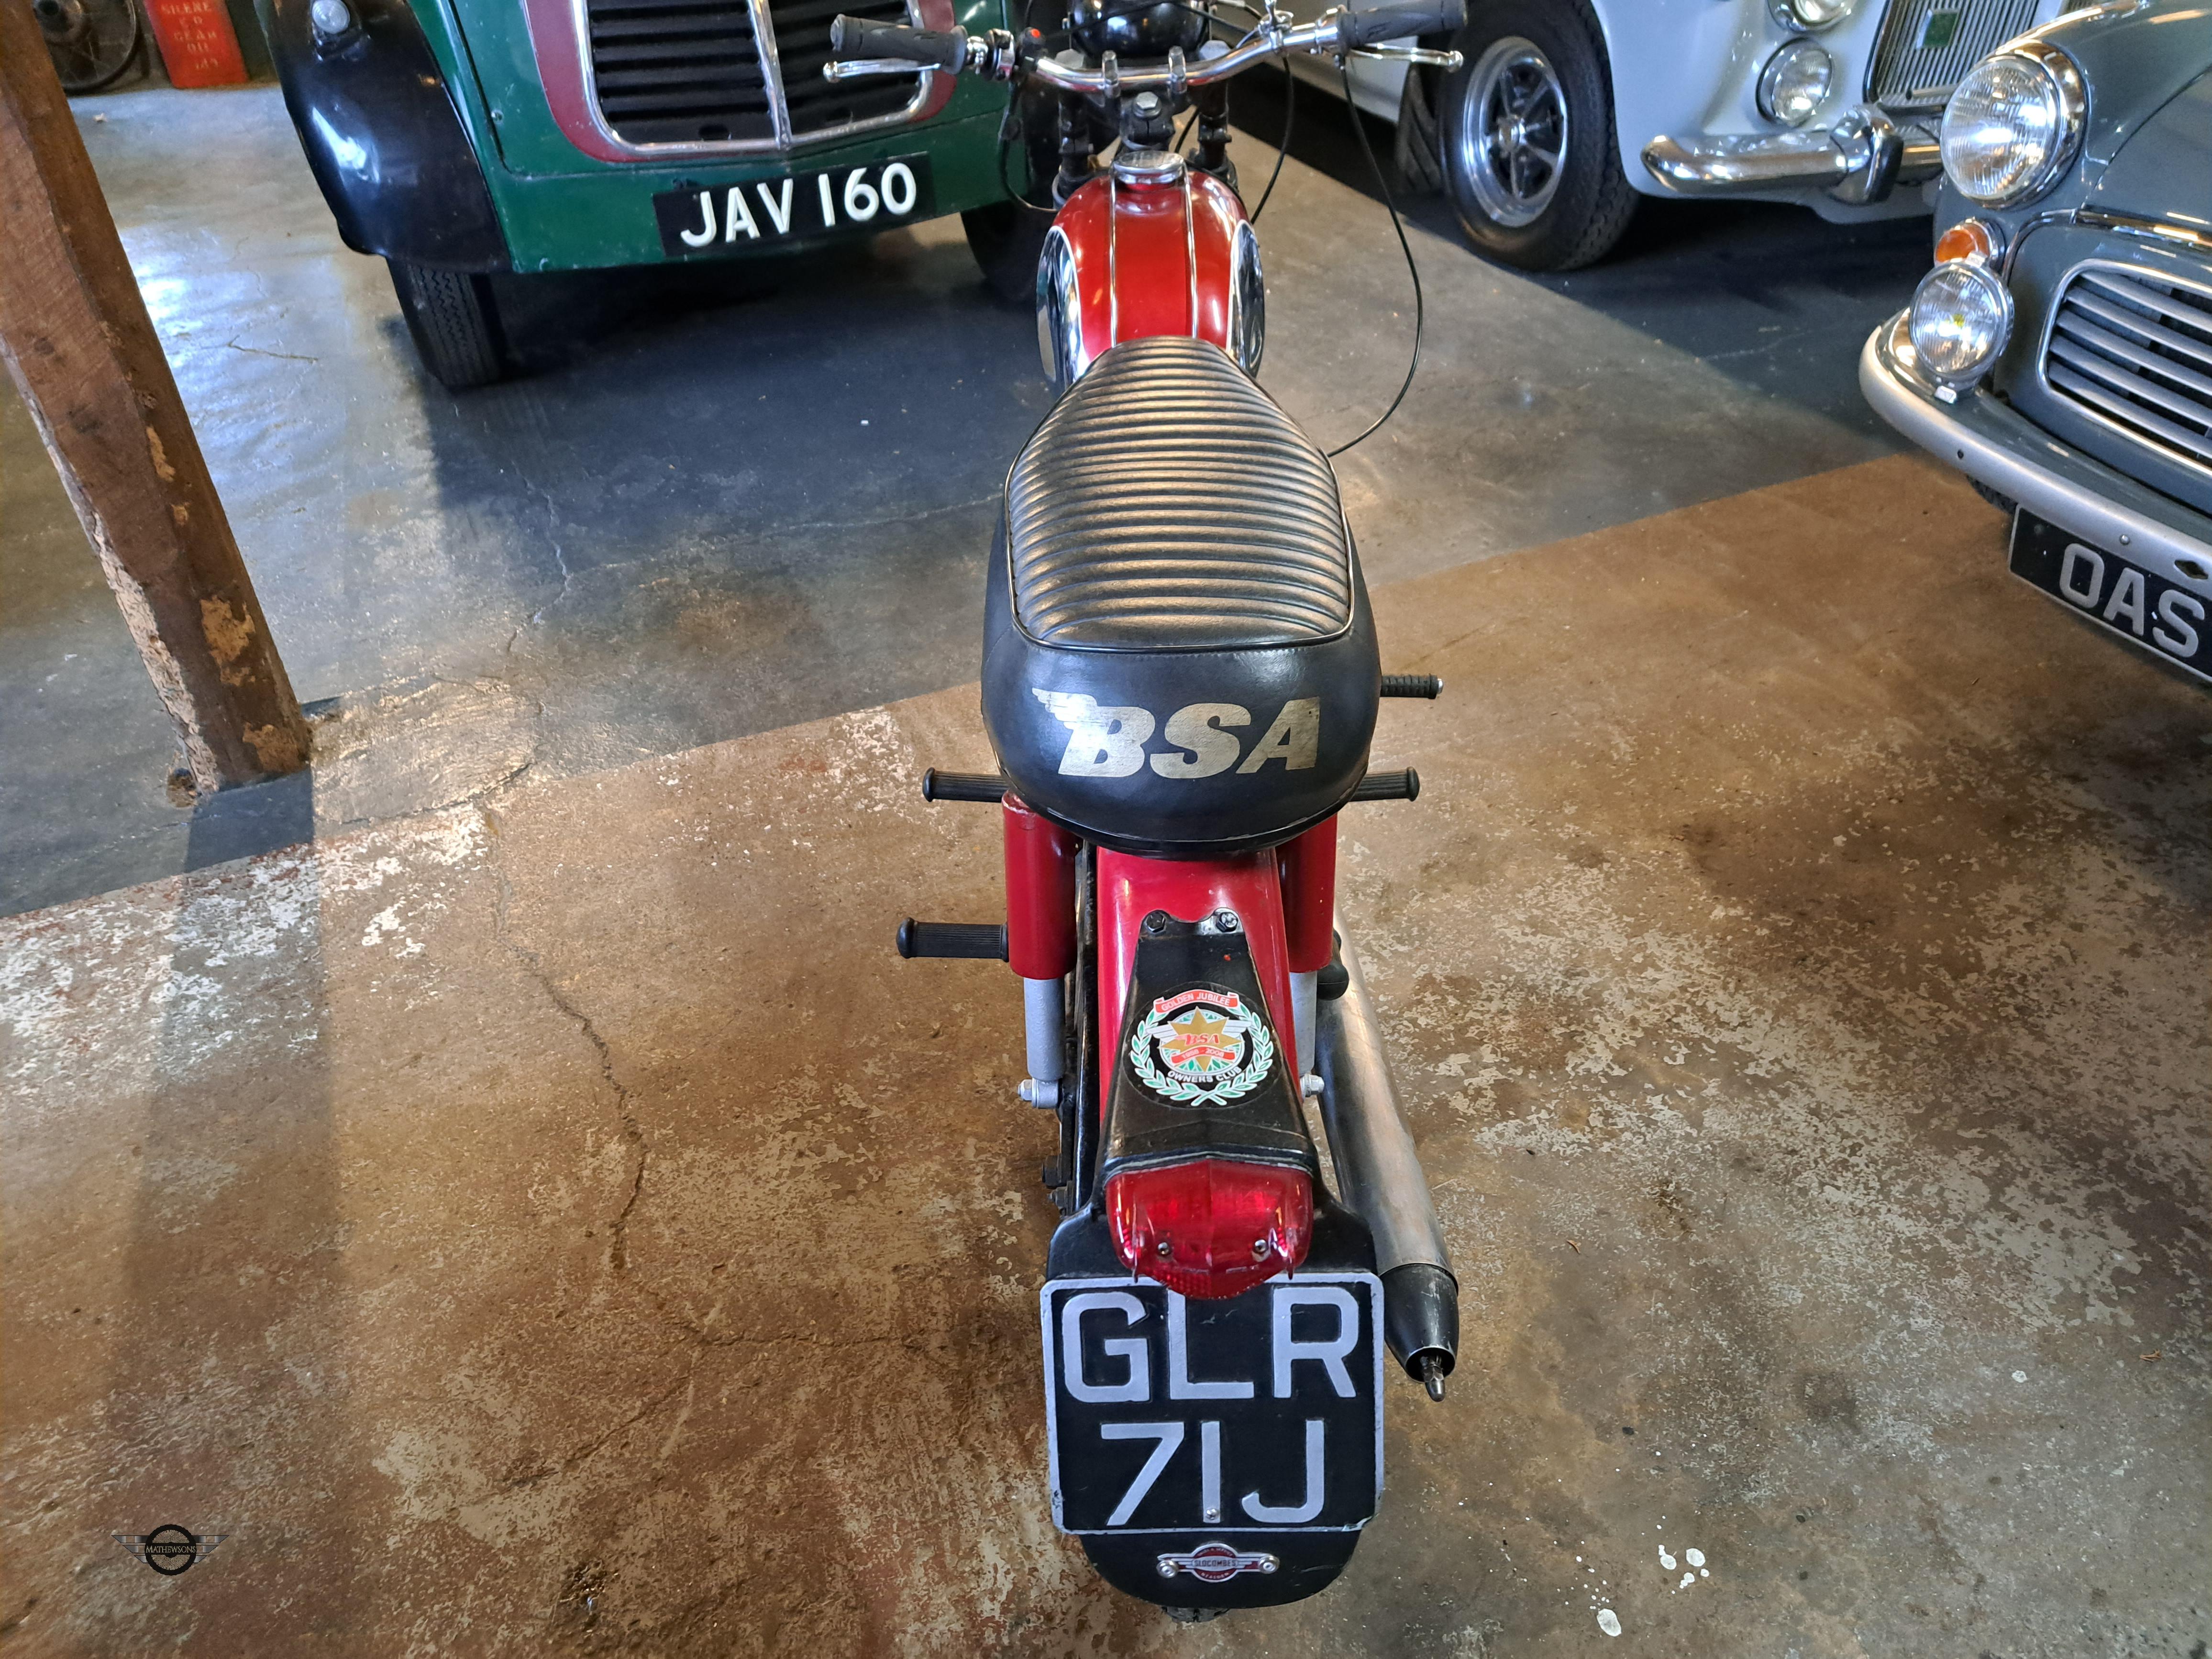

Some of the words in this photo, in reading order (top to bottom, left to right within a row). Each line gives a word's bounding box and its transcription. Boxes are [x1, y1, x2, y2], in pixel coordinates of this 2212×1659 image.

[680, 178, 793, 247] JAV
[818, 162, 917, 227] 160
[2059, 543, 2205, 657] OAS
[1032, 687, 1320, 779] BSA
[1161, 993, 1194, 1011] GOLDEN
[1196, 992, 1230, 1006] JUBILEE
[1175, 1033, 1220, 1046] BSA
[1167, 1071, 1214, 1083] OWNERS
[1216, 1066, 1242, 1081] CLUB
[1062, 1287, 1359, 1403] GLR
[1101, 1420, 1324, 1526] 71J
